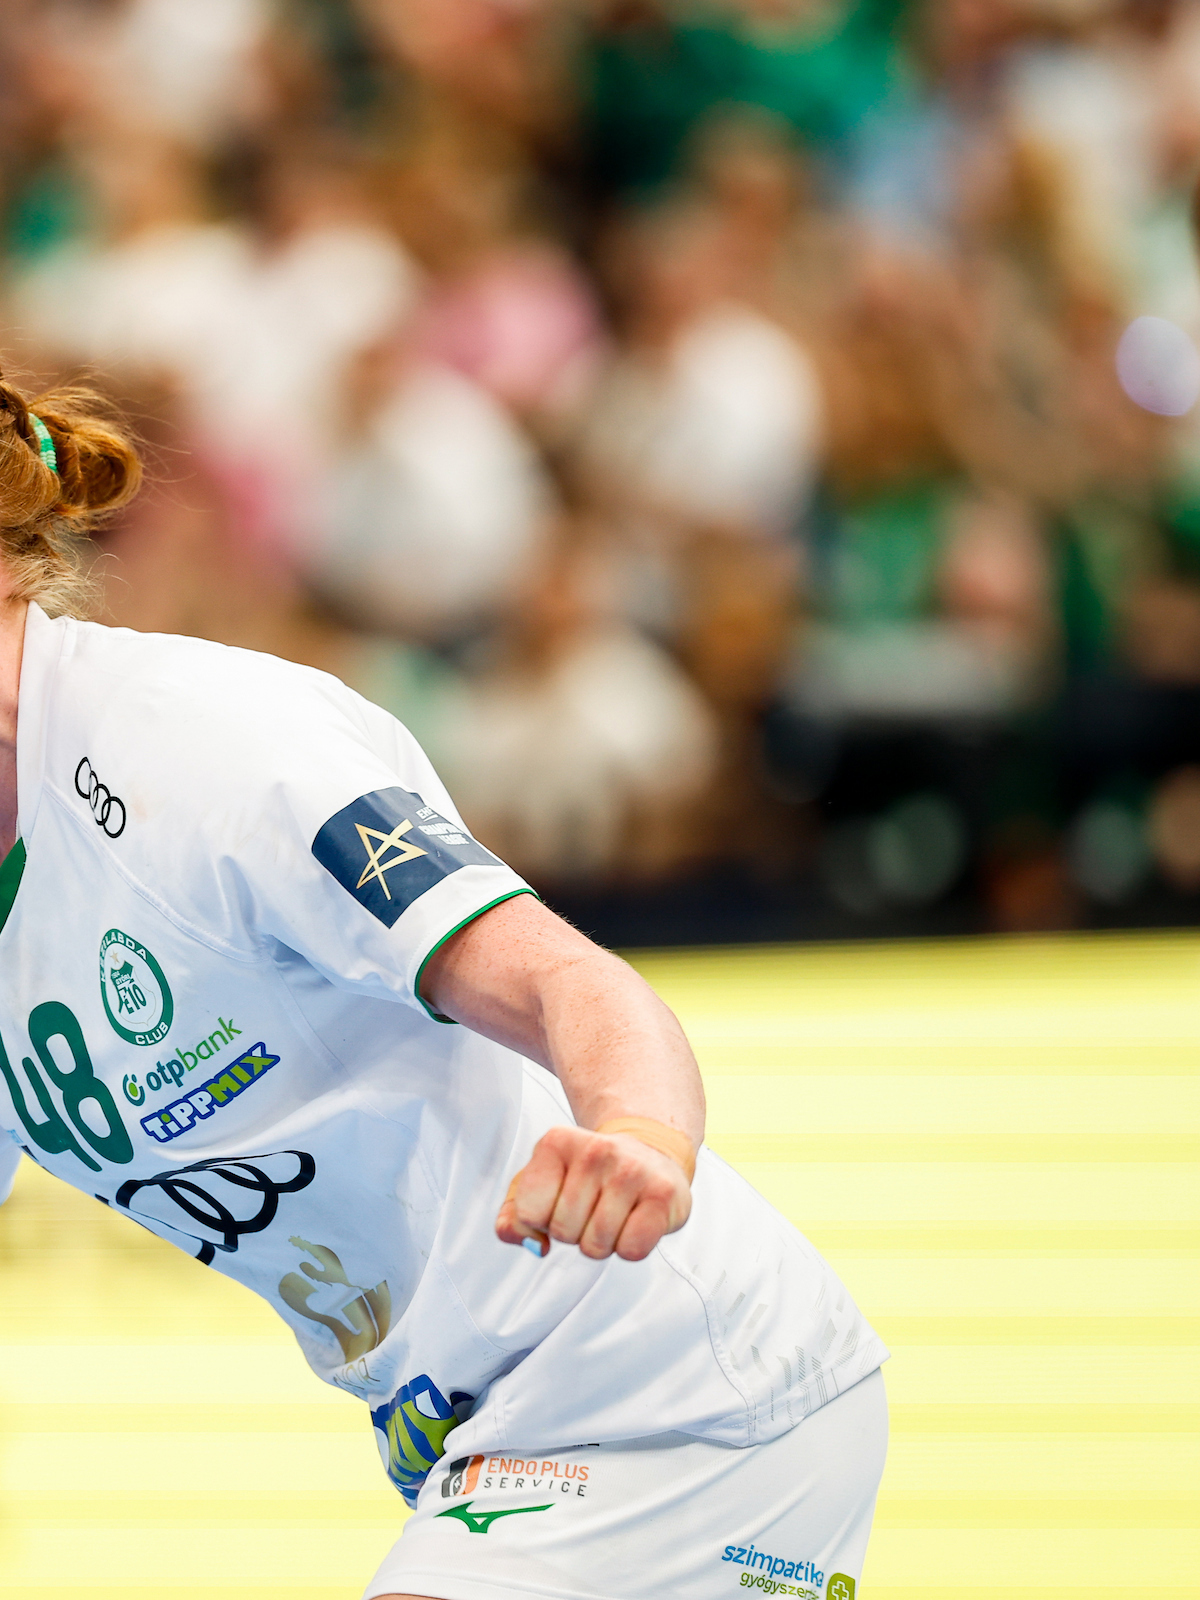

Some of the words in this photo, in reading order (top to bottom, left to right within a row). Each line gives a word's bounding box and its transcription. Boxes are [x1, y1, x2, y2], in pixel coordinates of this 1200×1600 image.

[135, 1021, 169, 1045] CLUB
[145, 1016, 243, 1089] otpbank
[484, 1476, 587, 1497] SERVICE
